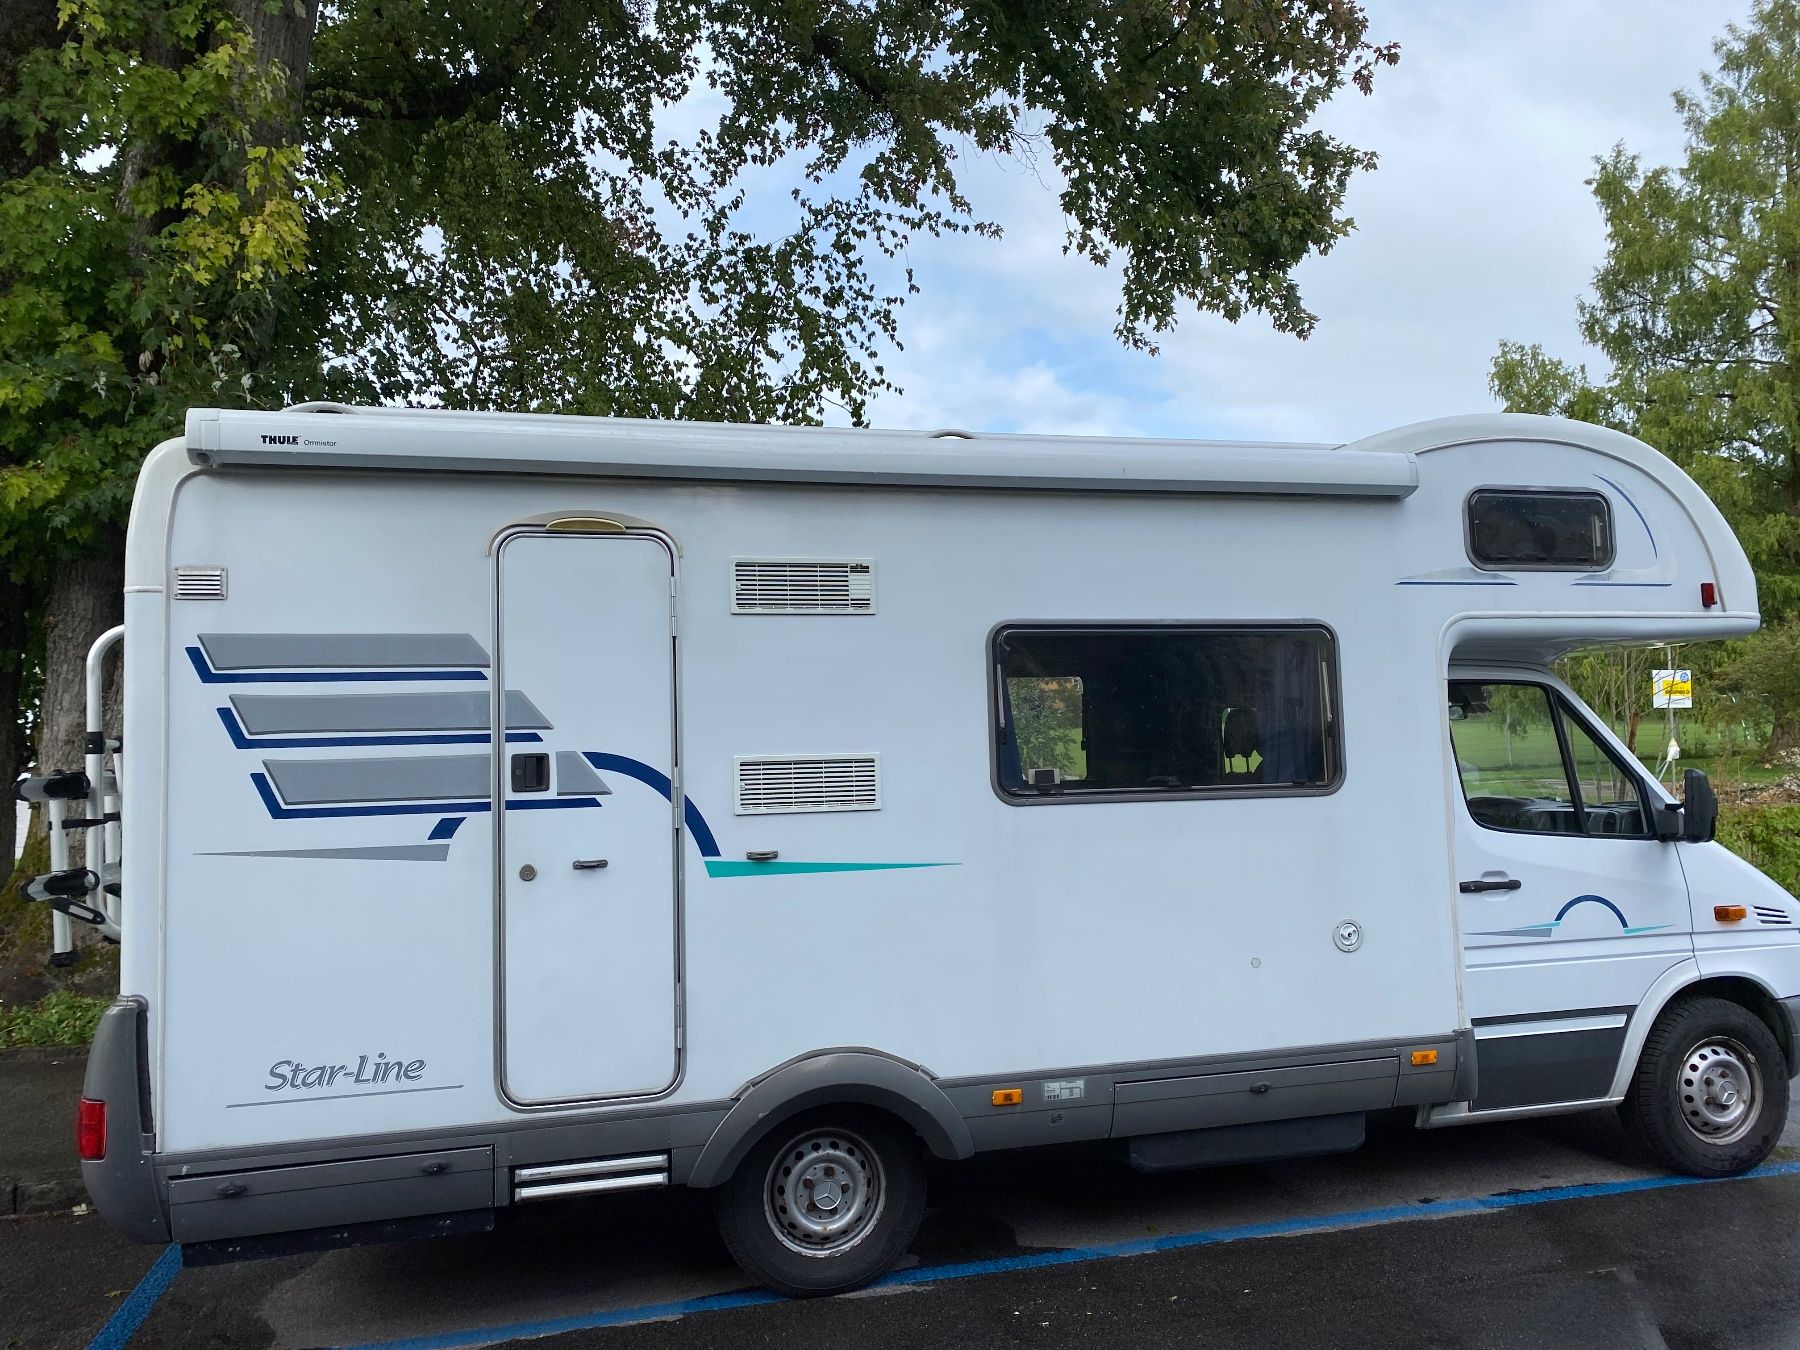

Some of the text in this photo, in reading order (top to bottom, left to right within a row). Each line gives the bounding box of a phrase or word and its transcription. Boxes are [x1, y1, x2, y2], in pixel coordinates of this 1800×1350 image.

[261, 434, 337, 447] THULE Omnistor
[264, 1052, 426, 1091] Star-Line
